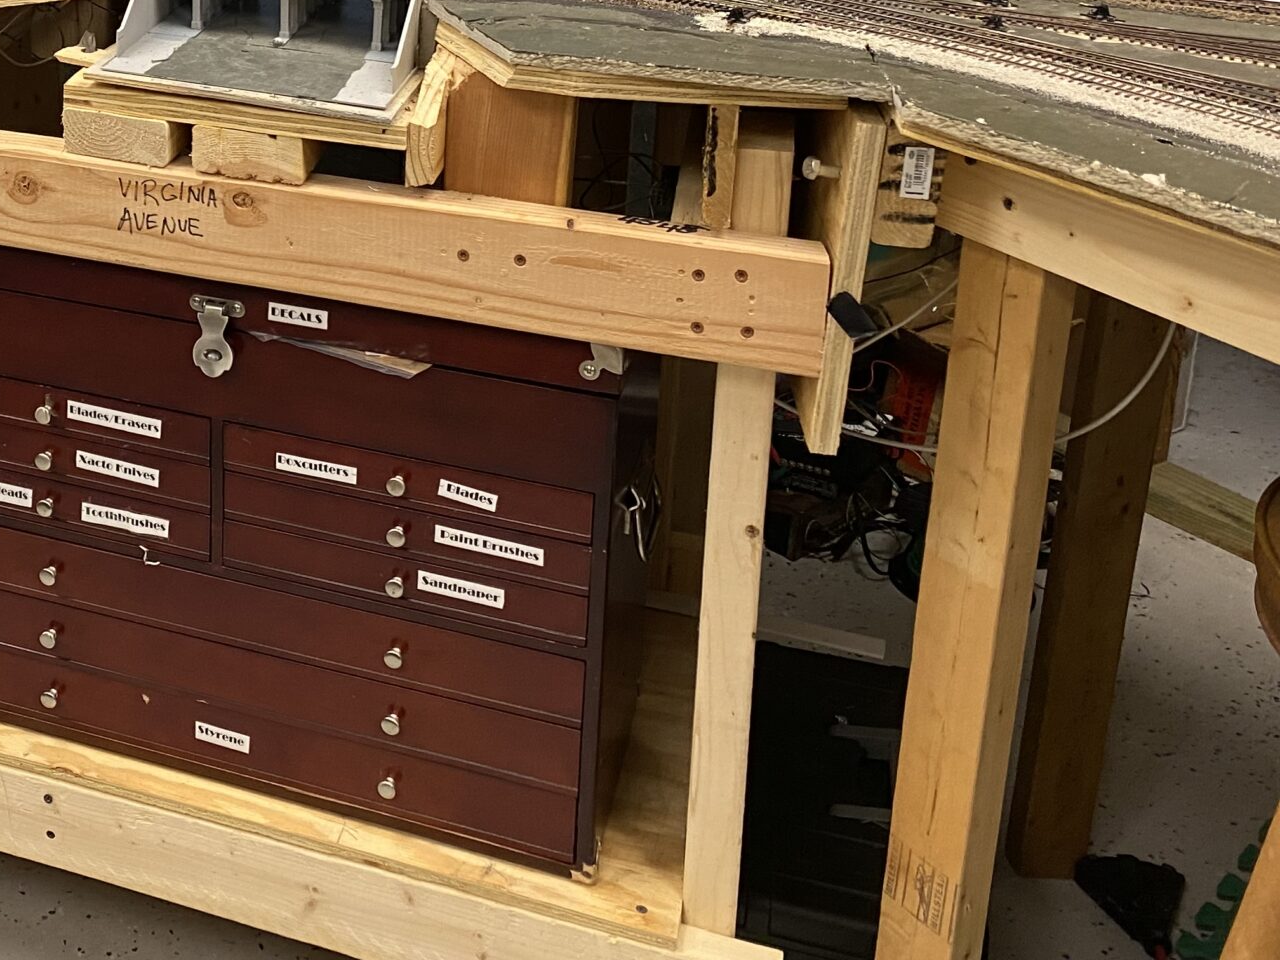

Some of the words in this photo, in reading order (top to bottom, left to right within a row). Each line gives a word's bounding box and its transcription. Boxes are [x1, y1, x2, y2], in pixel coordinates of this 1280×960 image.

[118, 177, 218, 208] VIRGINIA
[117, 207, 204, 237] AVENUE
[271, 306, 323, 324] DECALS
[69, 405, 160, 433] Blades/Erasers
[79, 454, 113, 470] Xacto
[115, 463, 156, 481] Knives
[277, 455, 349, 477] Boxcutters
[446, 483, 494, 506] Blades
[84, 505, 166, 532] Toothbrushes
[440, 529, 480, 547] Paint
[482, 539, 540, 561] Brushes
[422, 575, 501, 603] Sandpaper
[198, 725, 245, 746] Styrene
